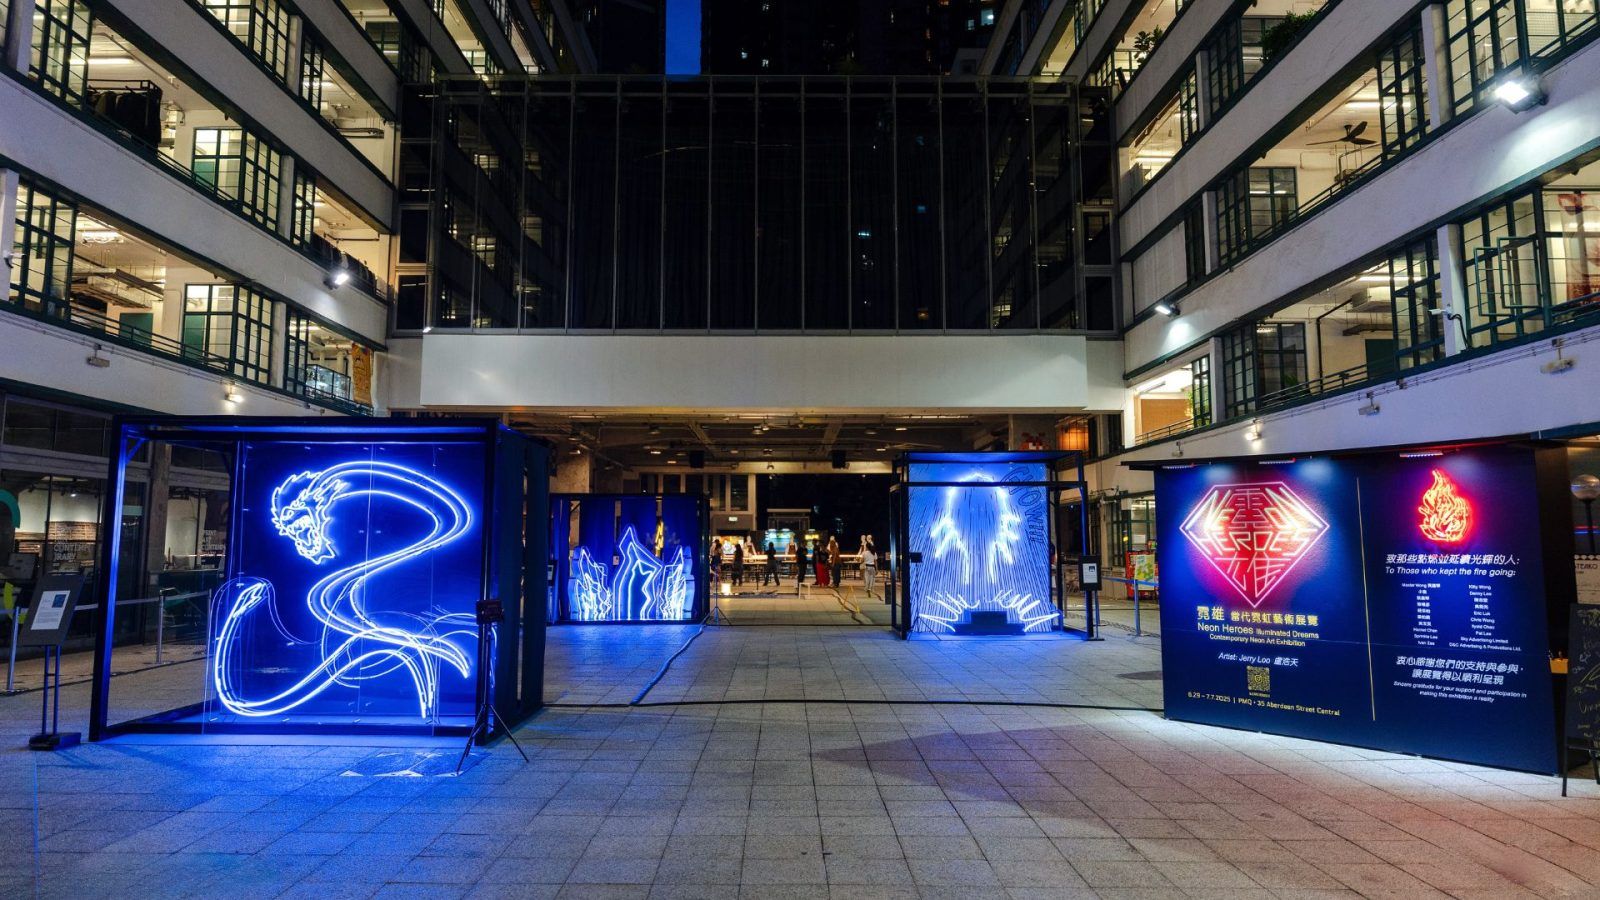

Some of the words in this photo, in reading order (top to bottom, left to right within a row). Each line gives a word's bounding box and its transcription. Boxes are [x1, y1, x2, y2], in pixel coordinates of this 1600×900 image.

[1188, 529, 1318, 556] HEROES
[1422, 567, 1437, 575] who
[1440, 567, 1457, 576] kept
[1460, 567, 1472, 575] the
[1489, 568, 1516, 577] going:
[1197, 605, 1225, 621] 霓雄
[1197, 623, 1220, 632] Neon
[1222, 624, 1254, 635] Heroes
[1256, 628, 1291, 638] Illuminated
[1292, 631, 1319, 640] Dreams
[1210, 633, 1249, 644] Contemporary
[1276, 639, 1306, 647] Exhibition
[1218, 652, 1238, 661] Artist:
[1238, 654, 1256, 664] Jerry
[1257, 655, 1271, 664] Loo
[1419, 690, 1438, 698] making
[1448, 693, 1473, 701] exhibition
[1455, 686, 1475, 694] support
[1487, 689, 1520, 698] participation
[1238, 698, 1252, 706] PMQ
[1266, 701, 1294, 711] Aberdeen
[1296, 704, 1315, 714] Street
[1317, 707, 1340, 716] Central
